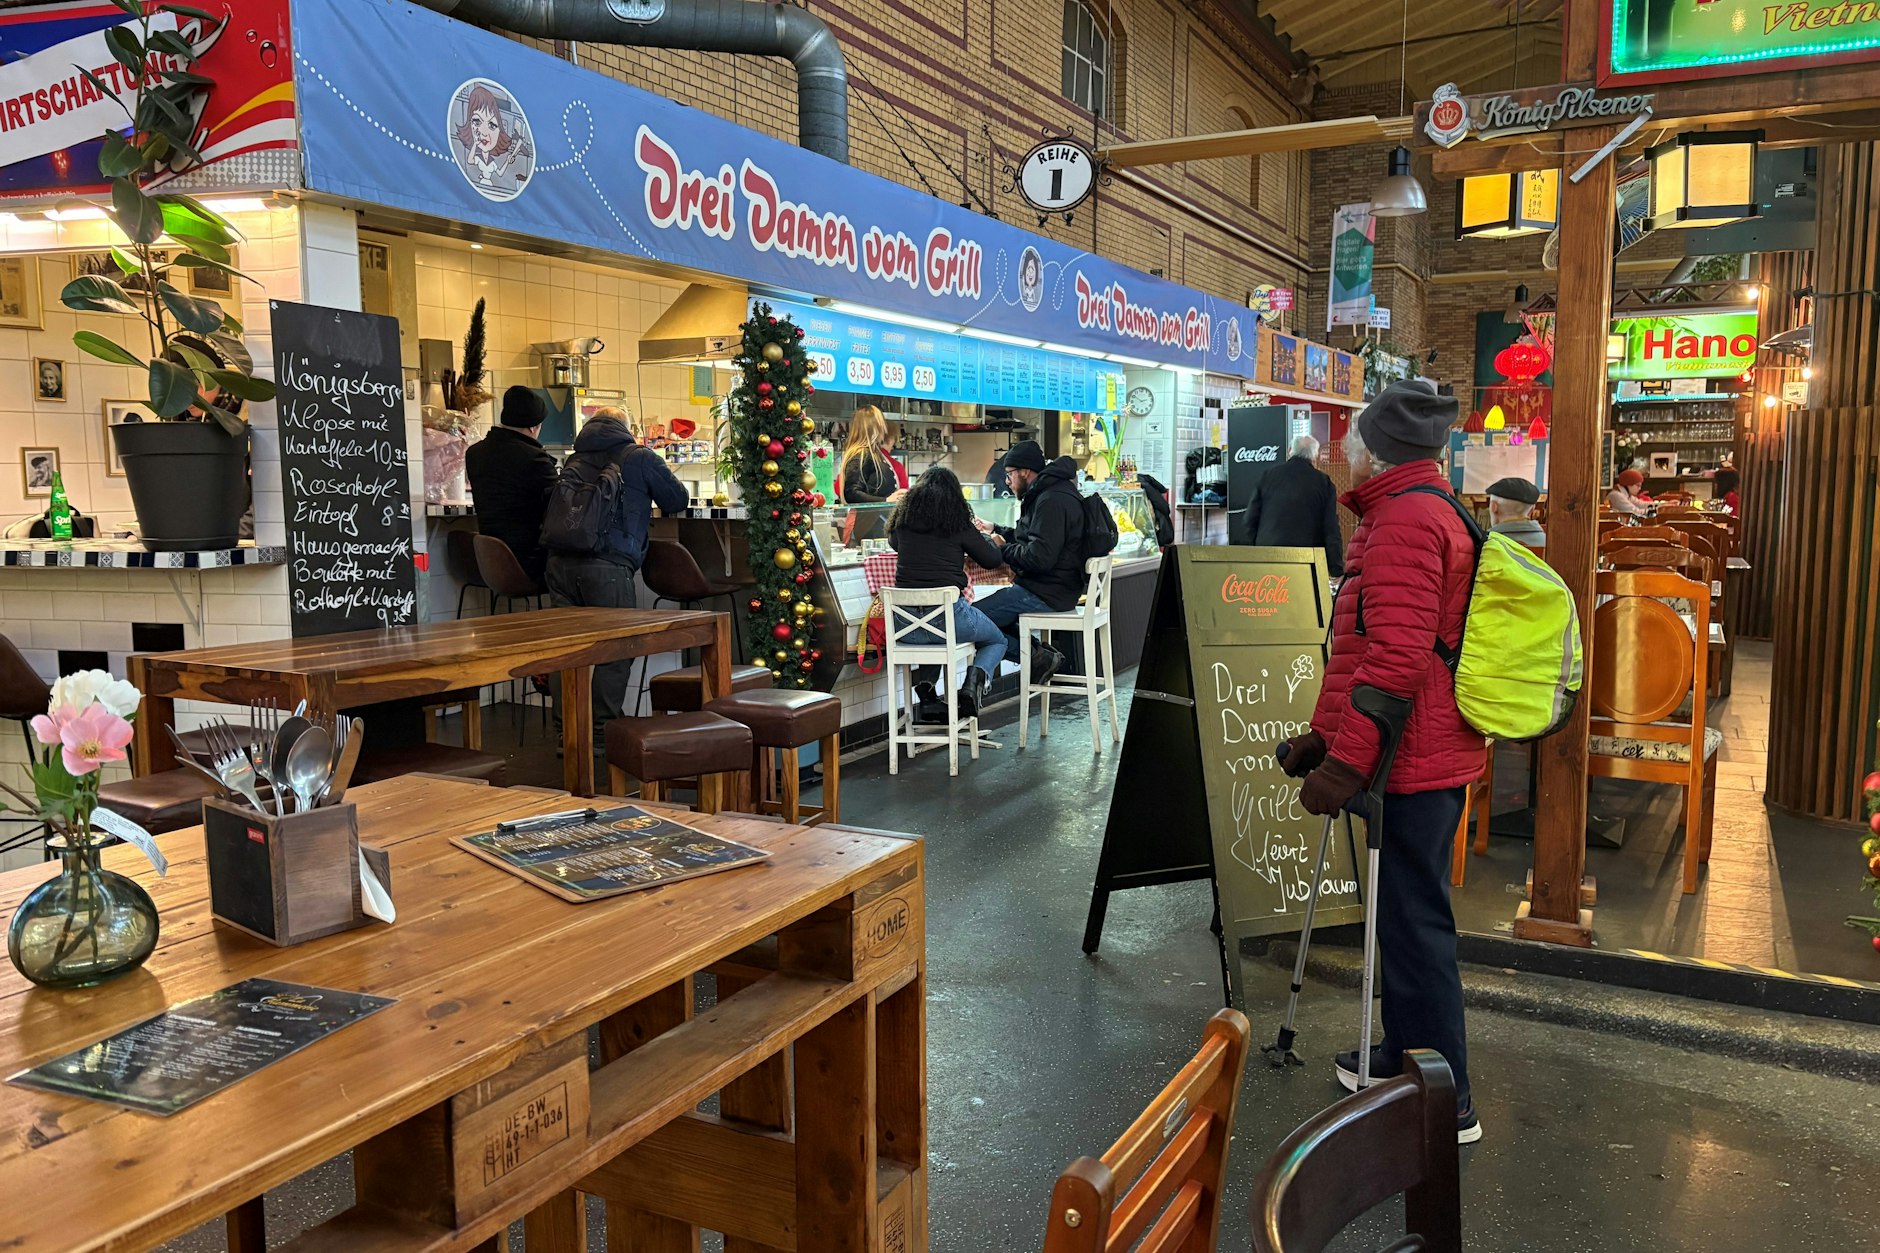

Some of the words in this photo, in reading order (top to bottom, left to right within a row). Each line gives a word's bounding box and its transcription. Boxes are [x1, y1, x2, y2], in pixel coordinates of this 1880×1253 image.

[1477, 95, 1557, 130] König
[1552, 87, 1655, 121] Pilsener
[1037, 147, 1079, 165] REIHE
[1047, 168, 1064, 201] 1
[636, 126, 735, 239] Drei
[741, 159, 857, 271] Damen
[863, 226, 919, 288] vom
[925, 228, 981, 299] Grill
[1075, 270, 1111, 331] Drei
[1112, 281, 1159, 342] Damen
[1160, 312, 1182, 348] vom
[1184, 307, 1210, 352] Grill
[803, 336, 841, 350] URRYWURST
[1644, 328, 1757, 360] Hano
[850, 361, 872, 382] 3,50
[885, 366, 903, 384] 5,95
[915, 369, 934, 389] 2,50
[361, 413, 390, 432] mit
[1234, 445, 1280, 463] Coca-Cola
[293, 500, 359, 537] Eintopf
[1221, 573, 1290, 604] Coca-Cola
[1211, 662, 1269, 705] Drei
[867, 908, 906, 949] HOME
[504, 1096, 547, 1134] DE-BW
[505, 1105, 563, 1149] 49-1-1-036
[506, 1147, 521, 1169] HT
